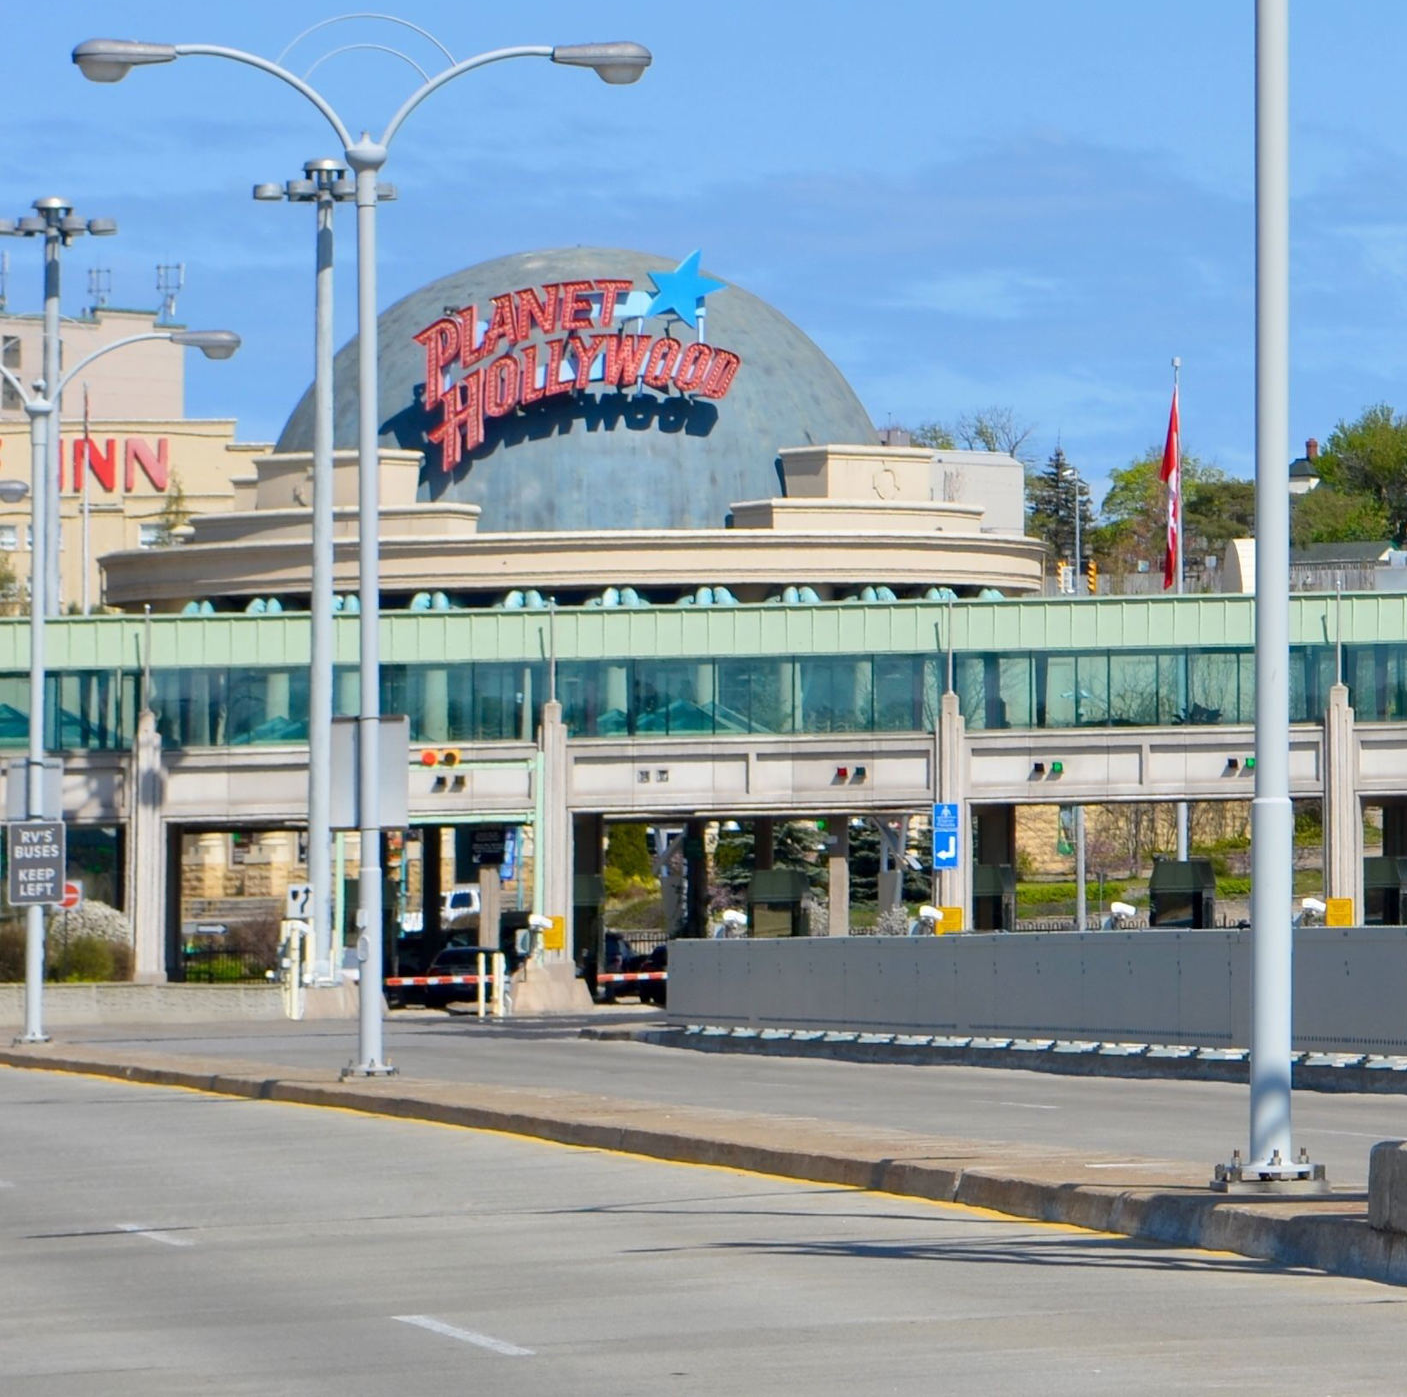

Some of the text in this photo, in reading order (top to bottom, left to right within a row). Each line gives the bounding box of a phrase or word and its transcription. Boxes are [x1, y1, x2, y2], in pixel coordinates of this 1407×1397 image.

[413, 279, 634, 412] PLANET
[428, 333, 741, 472] HOLLYWOOD
[14, 844, 60, 859] BUSES
[18, 868, 55, 881] KEEP
[19, 883, 54, 897] LEFT
